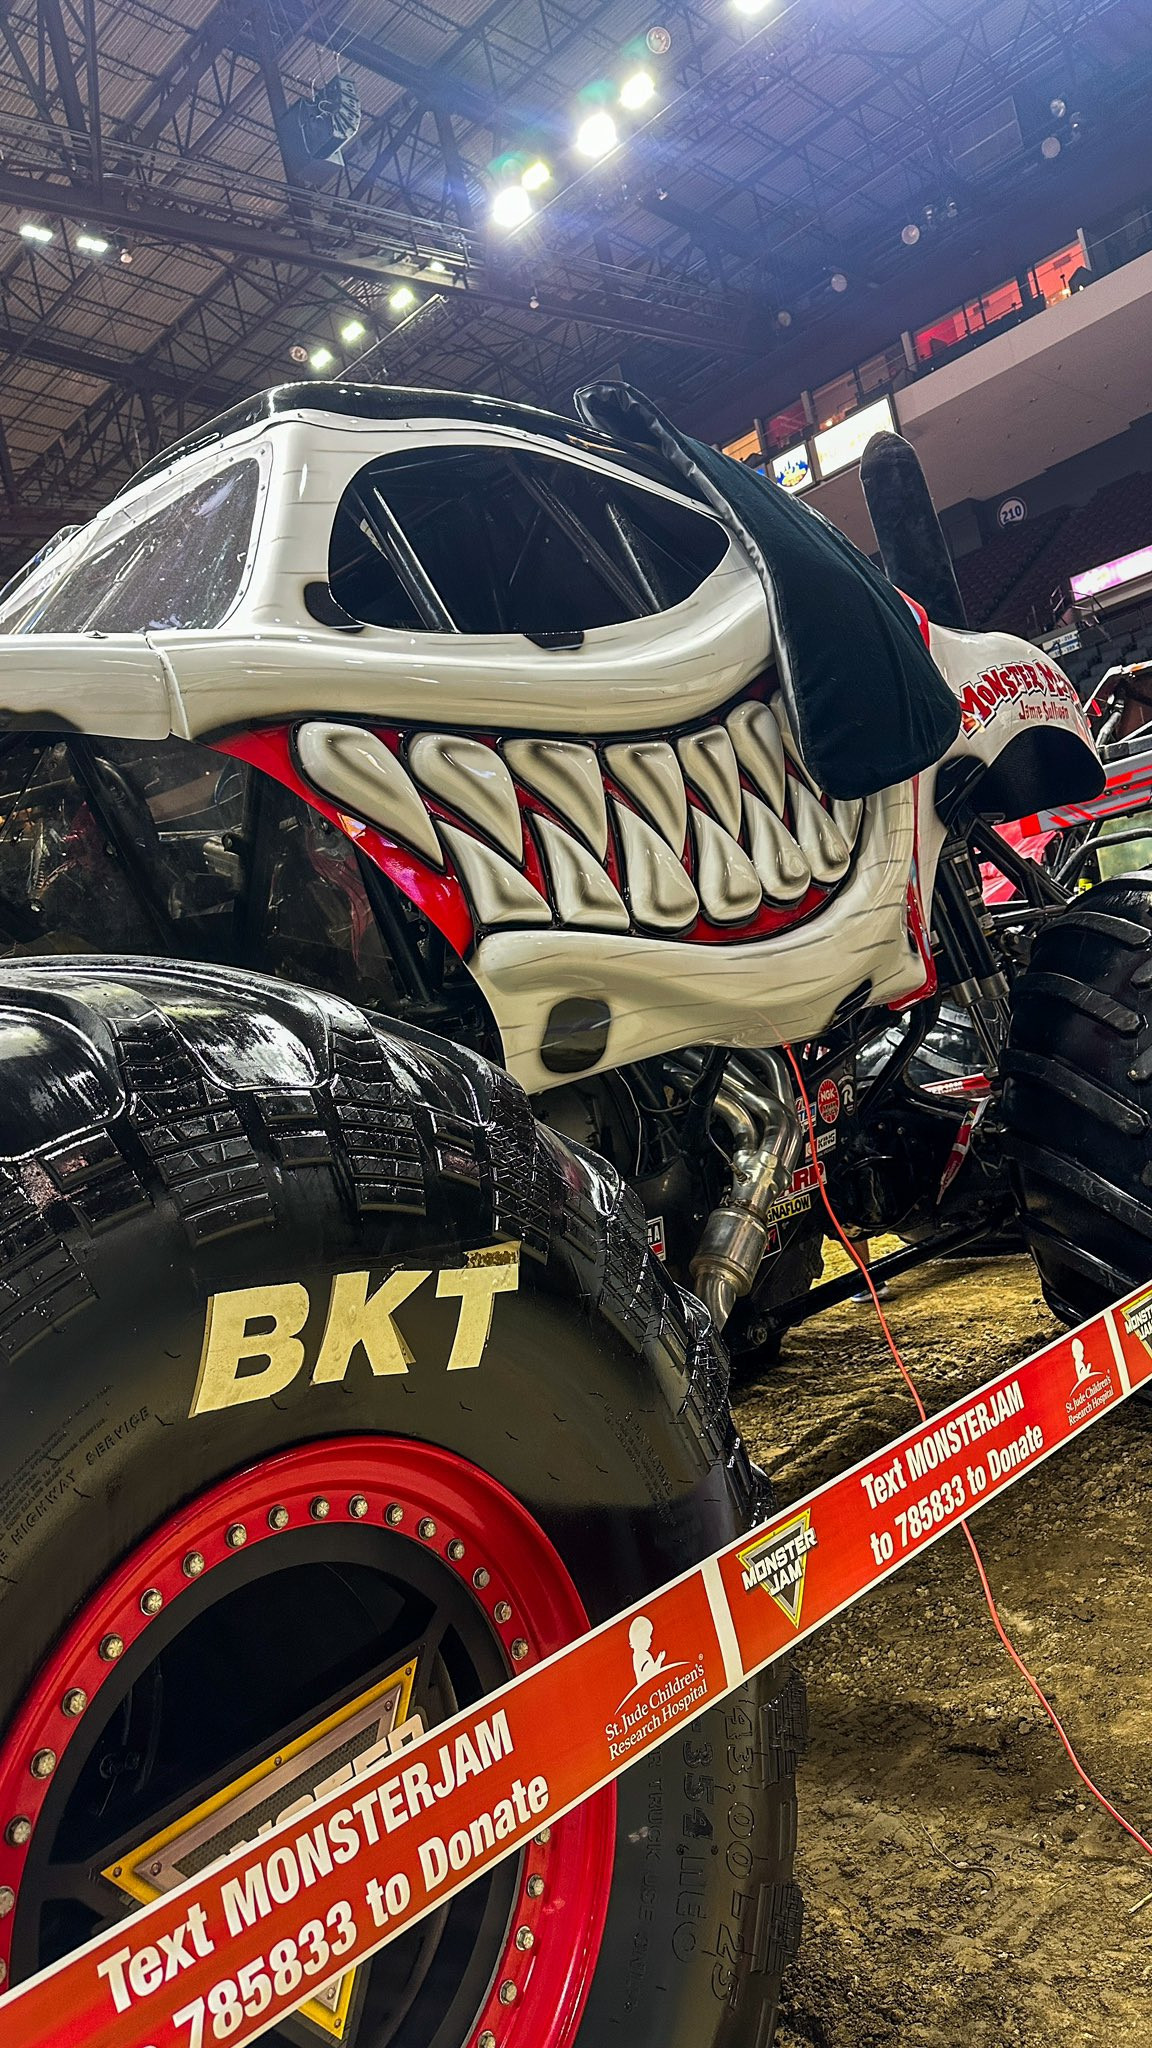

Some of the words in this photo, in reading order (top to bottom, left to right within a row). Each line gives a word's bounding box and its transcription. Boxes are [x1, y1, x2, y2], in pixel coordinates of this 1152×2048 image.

[1001, 504, 1022, 523] 210
[959, 661, 1046, 737] MONSTER
[820, 1087, 836, 1102] NGK
[767, 1194, 810, 1222] GNAFLOW
[190, 1262, 520, 1416] BKT
[1124, 1303, 1152, 1335] MONST
[1068, 1402, 1093, 1426] Research
[1091, 1385, 1114, 1409] Hospital
[1072, 1393, 1086, 1411] Jude
[10, 1467, 76, 1546] HIGHWAY
[85, 1405, 150, 1466] SERVICE
[860, 1457, 908, 1510] Text
[904, 1379, 1025, 1482] MONSTERJAM
[869, 1531, 894, 1566] to
[893, 1474, 966, 1548] 785833
[965, 1465, 987, 1496] to
[986, 1424, 1044, 1482] Donate
[741, 1526, 818, 1591] MONSTER
[769, 1558, 803, 1597] JAM
[605, 1720, 623, 1742] St.
[620, 1703, 649, 1735] Jude
[648, 1663, 705, 1710] Children's
[608, 1714, 662, 1761] Research
[660, 1678, 709, 1724] Hospital
[646, 1777, 663, 1861] TRUCK
[97, 1911, 215, 2014] Text
[219, 1708, 515, 1938] MONSTERJAM
[172, 1899, 358, 2048] 785833
[365, 1865, 411, 1928] to
[415, 1773, 550, 1893] Donate
